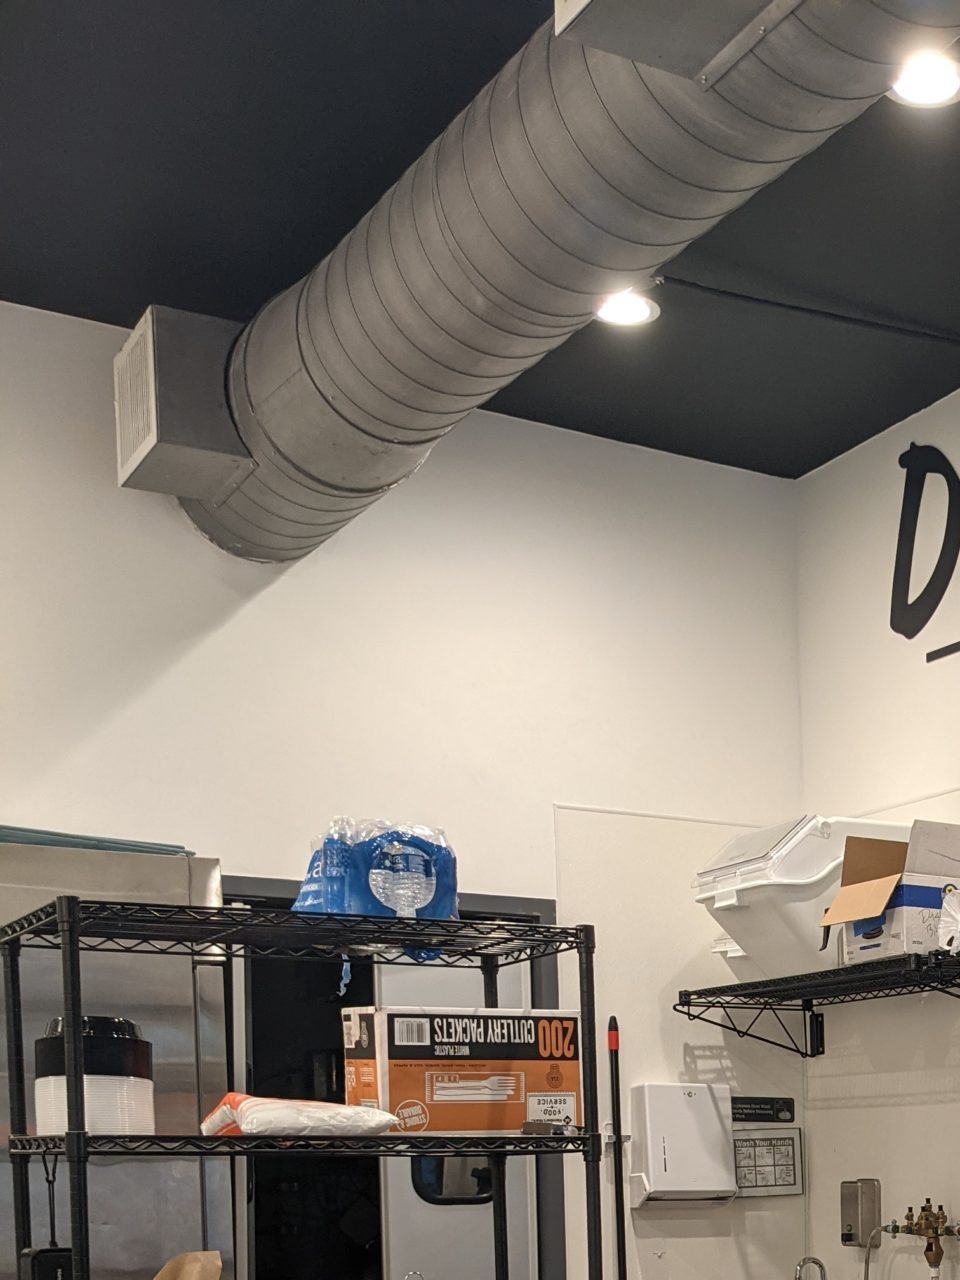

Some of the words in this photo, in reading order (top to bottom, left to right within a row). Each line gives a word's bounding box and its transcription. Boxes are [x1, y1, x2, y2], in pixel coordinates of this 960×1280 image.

[433, 1017, 484, 1043] PACKETS
[485, 1018, 535, 1043] CUTLERY
[538, 1019, 575, 1058] 200
[434, 1044, 454, 1056] PLASTIC
[454, 1045, 471, 1056] WHITE
[536, 1098, 567, 1106] SERVICE
[543, 1108, 562, 1116] FOOD
[755, 1139, 770, 1147] Your
[772, 1138, 793, 1146] Hands
